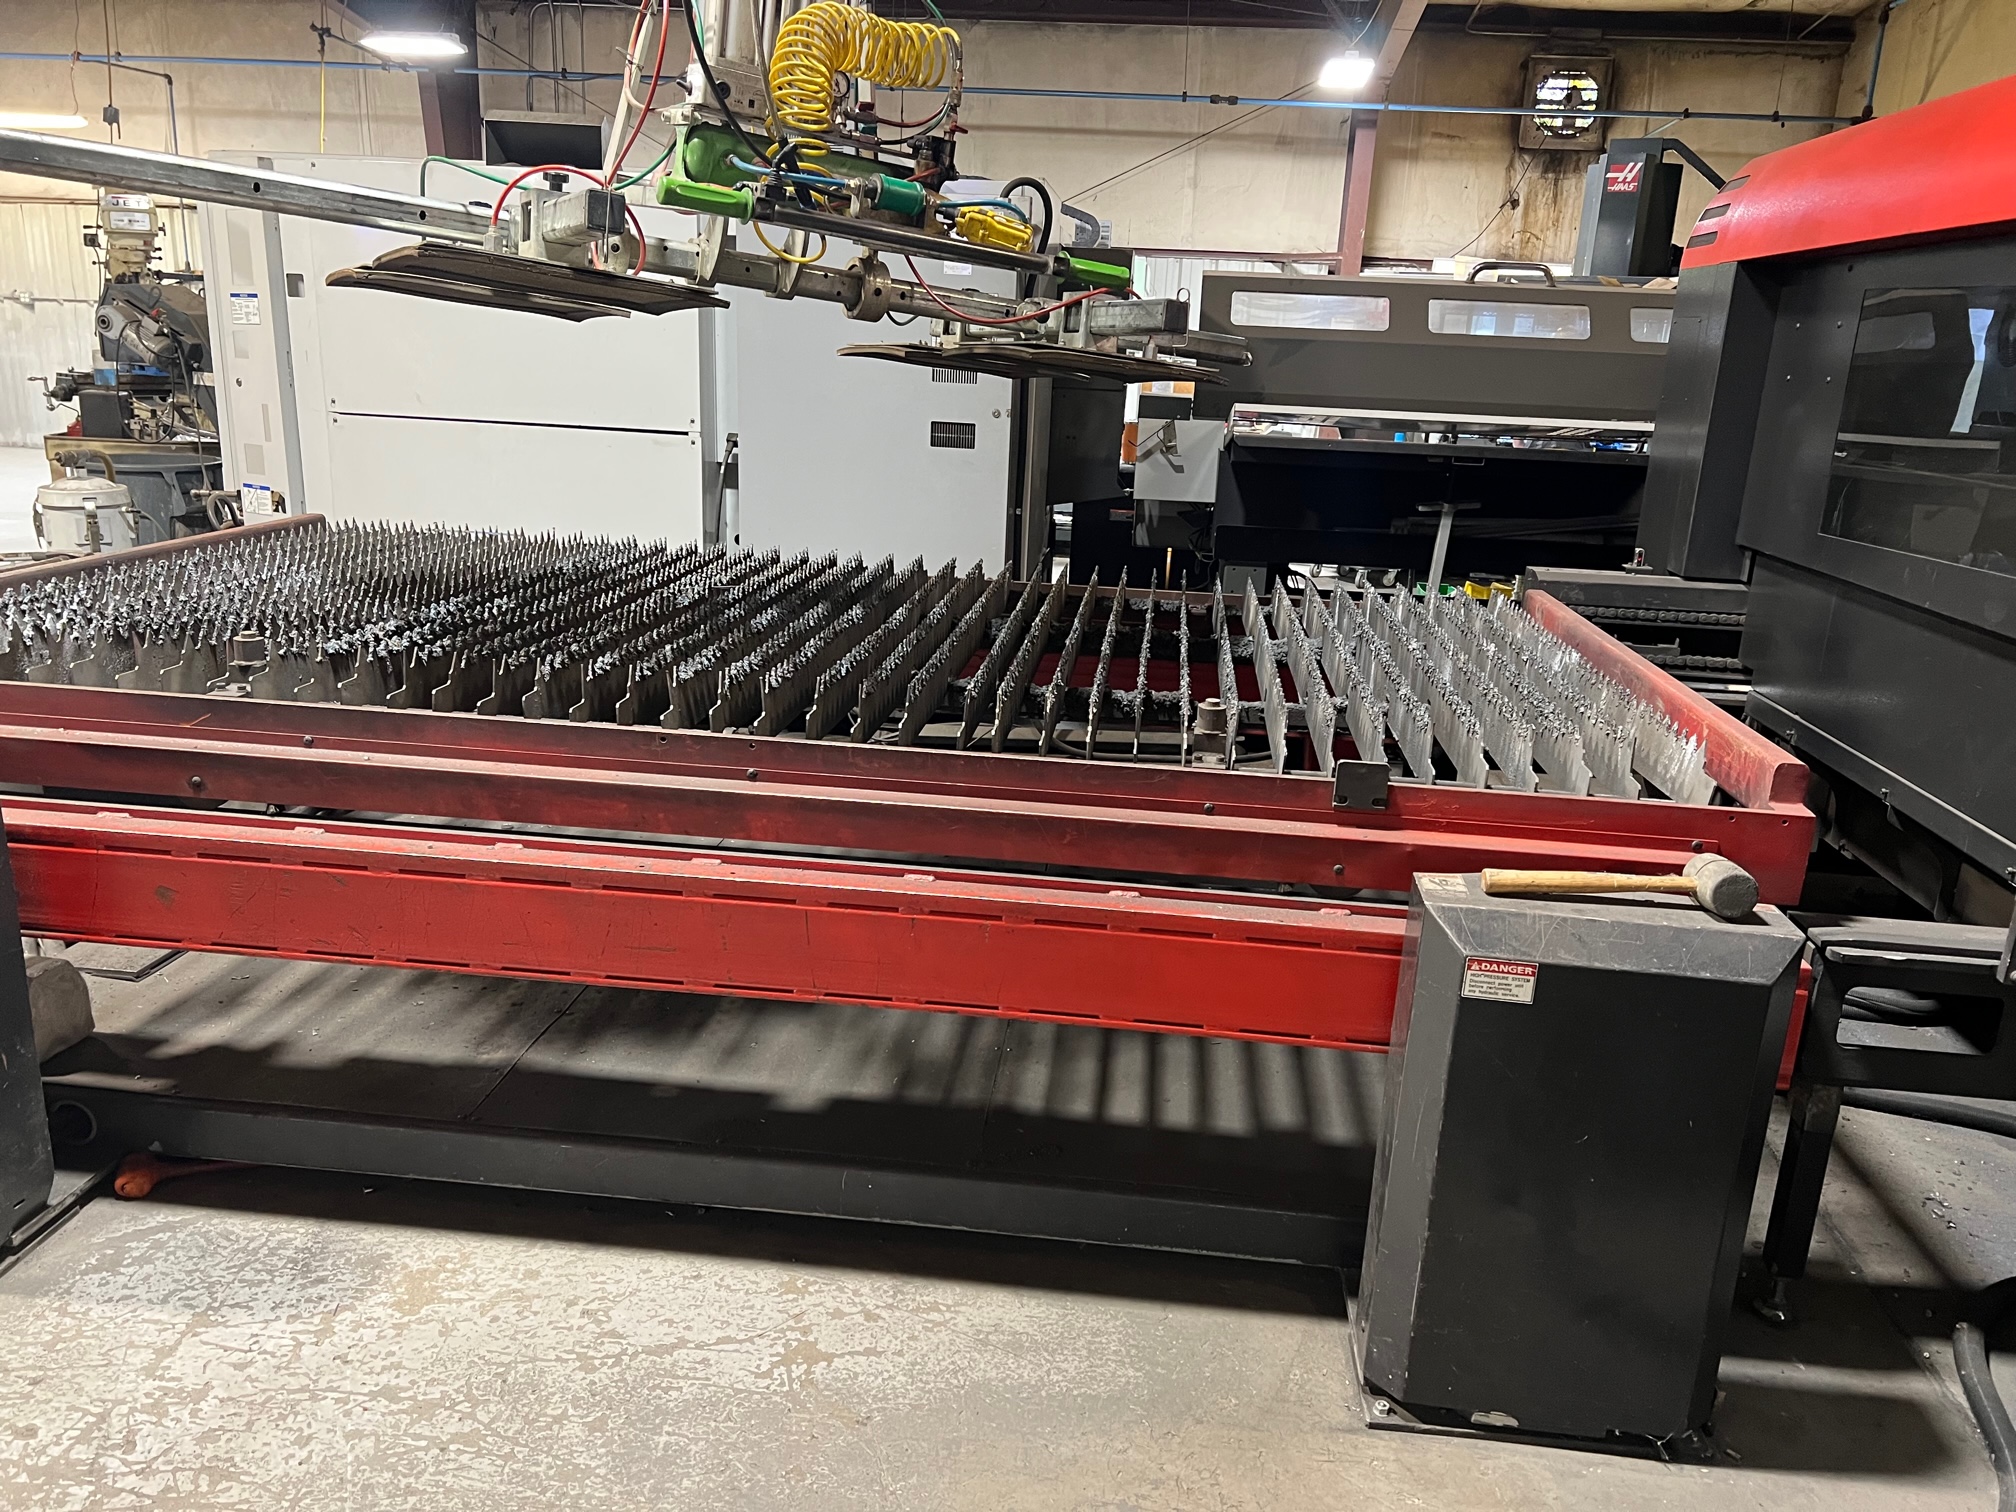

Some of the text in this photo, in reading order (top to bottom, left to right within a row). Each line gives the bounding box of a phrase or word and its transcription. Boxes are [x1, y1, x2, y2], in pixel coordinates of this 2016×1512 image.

[1607, 182, 1638, 191] HAAS
[112, 199, 142, 207] JET
[1481, 963, 1532, 975] DANGER
